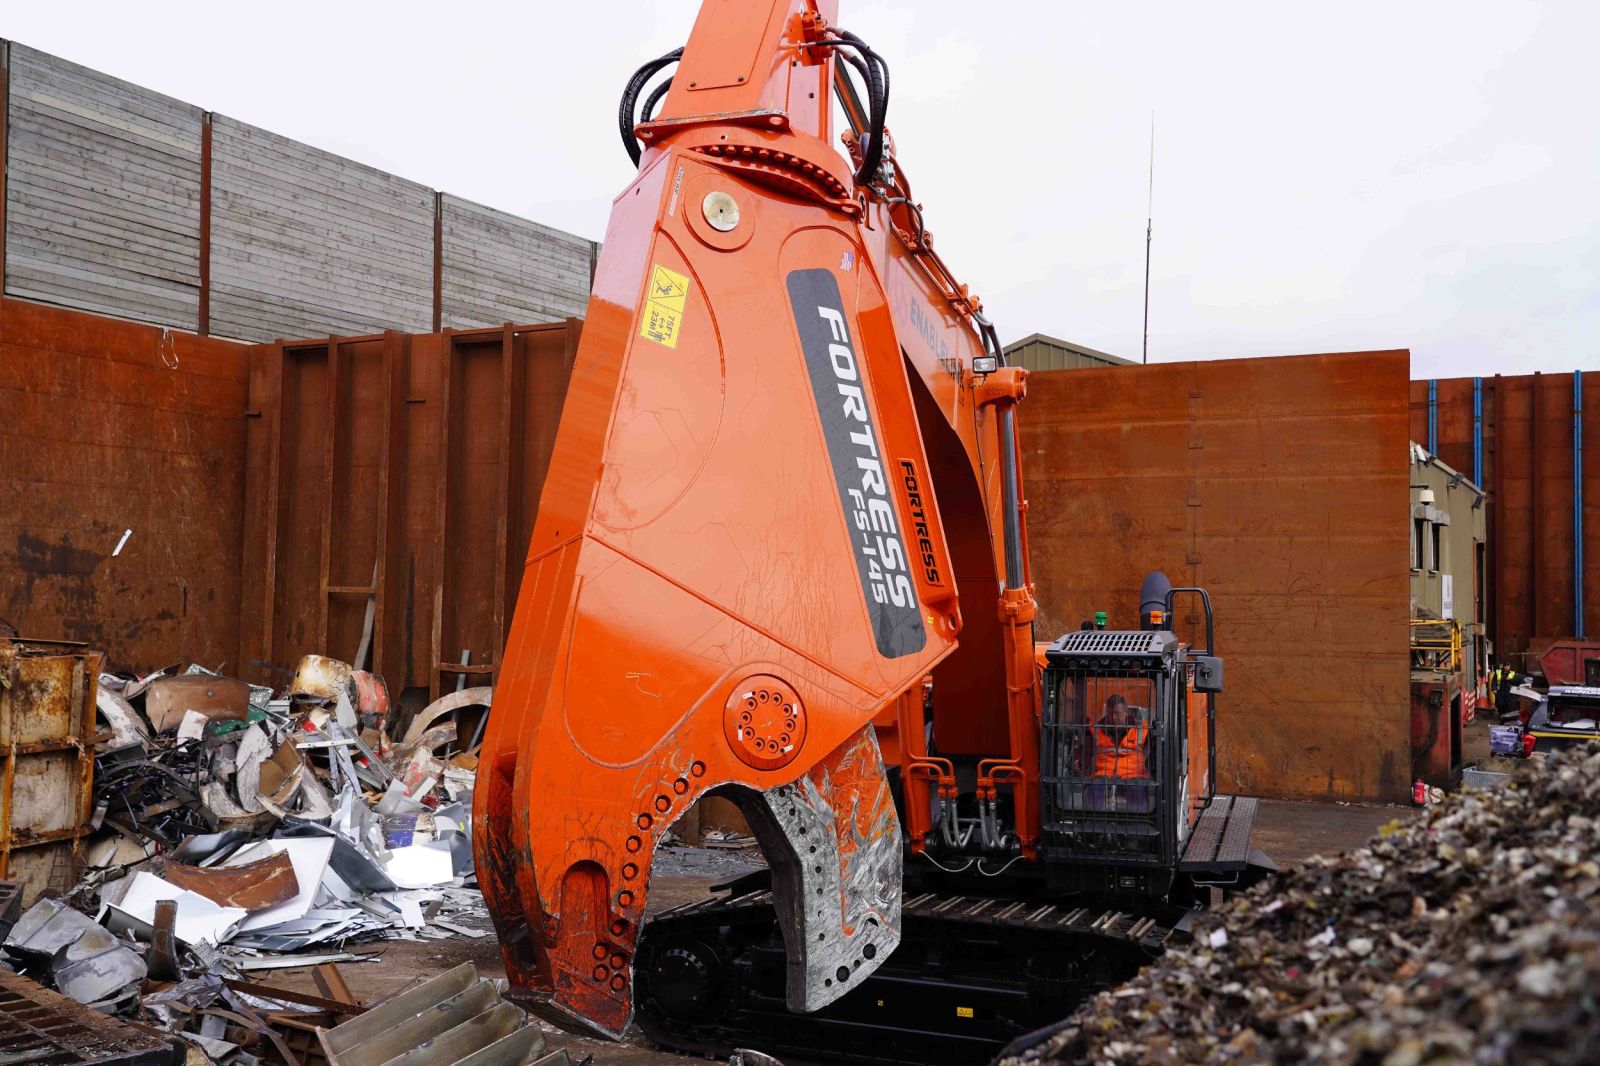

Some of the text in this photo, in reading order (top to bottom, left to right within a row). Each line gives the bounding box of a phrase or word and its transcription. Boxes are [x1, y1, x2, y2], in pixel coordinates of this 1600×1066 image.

[649, 310, 659, 331] 23M
[817, 305, 916, 609] FORTRESS
[847, 488, 889, 604] FS-145
[901, 461, 940, 583] FORTRESS
